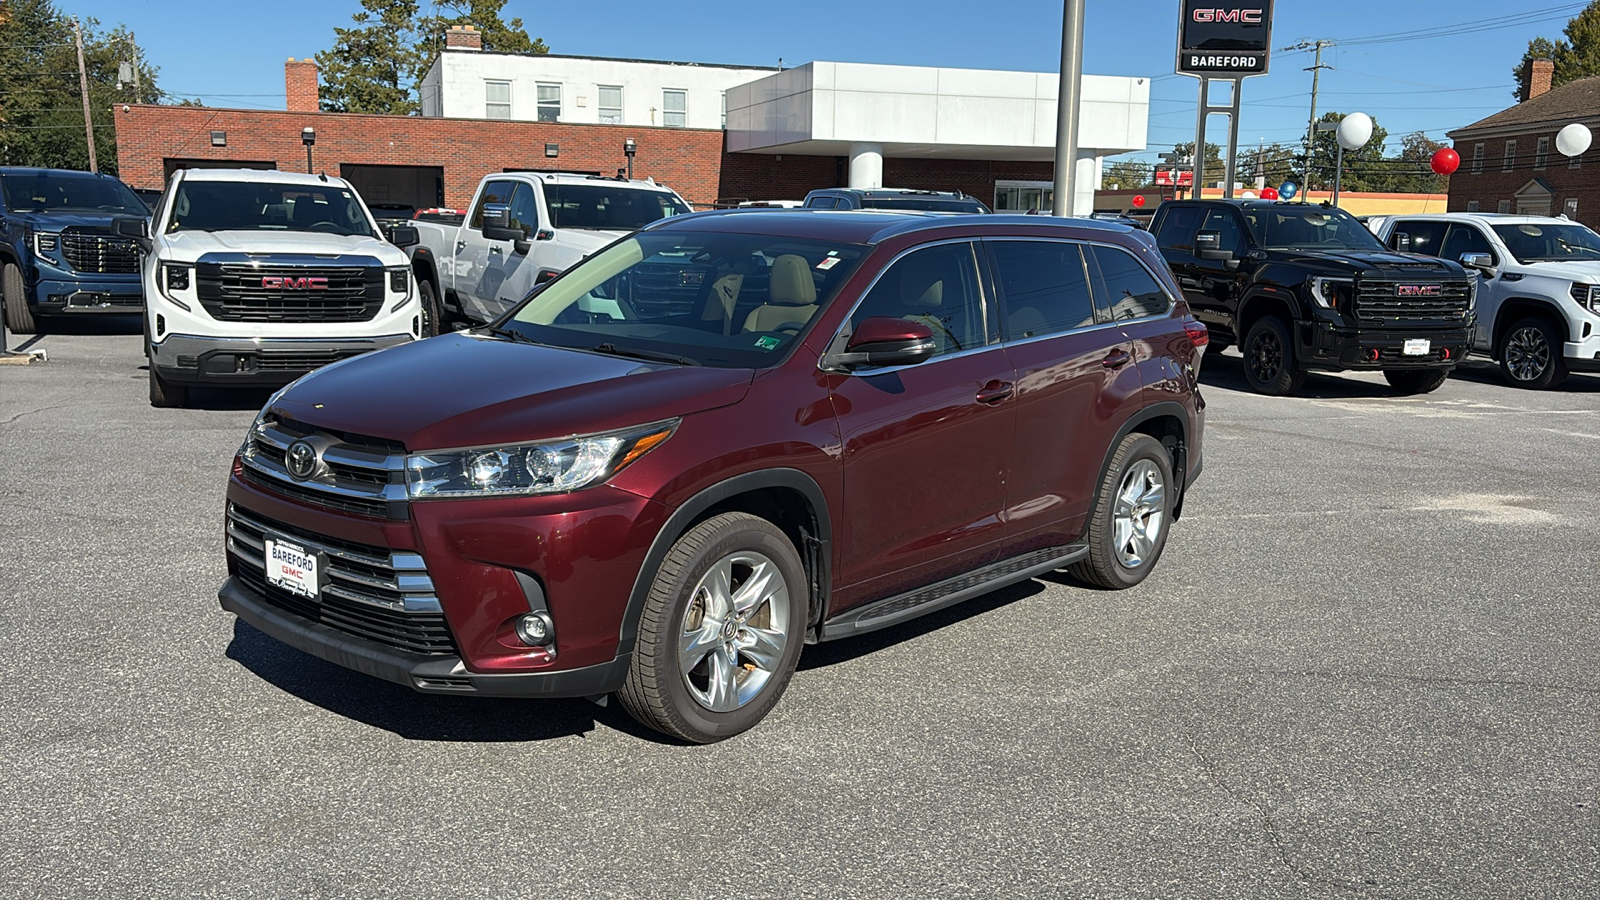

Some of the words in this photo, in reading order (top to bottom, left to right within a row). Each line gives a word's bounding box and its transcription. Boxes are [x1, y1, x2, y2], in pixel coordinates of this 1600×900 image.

[1193, 8, 1262, 22] GMC
[1191, 56, 1256, 67] BAREFORD
[262, 276, 328, 289] GMC
[1399, 285, 1440, 295] GMC
[273, 548, 313, 571] BAREFORD
[282, 565, 303, 579] GMC
